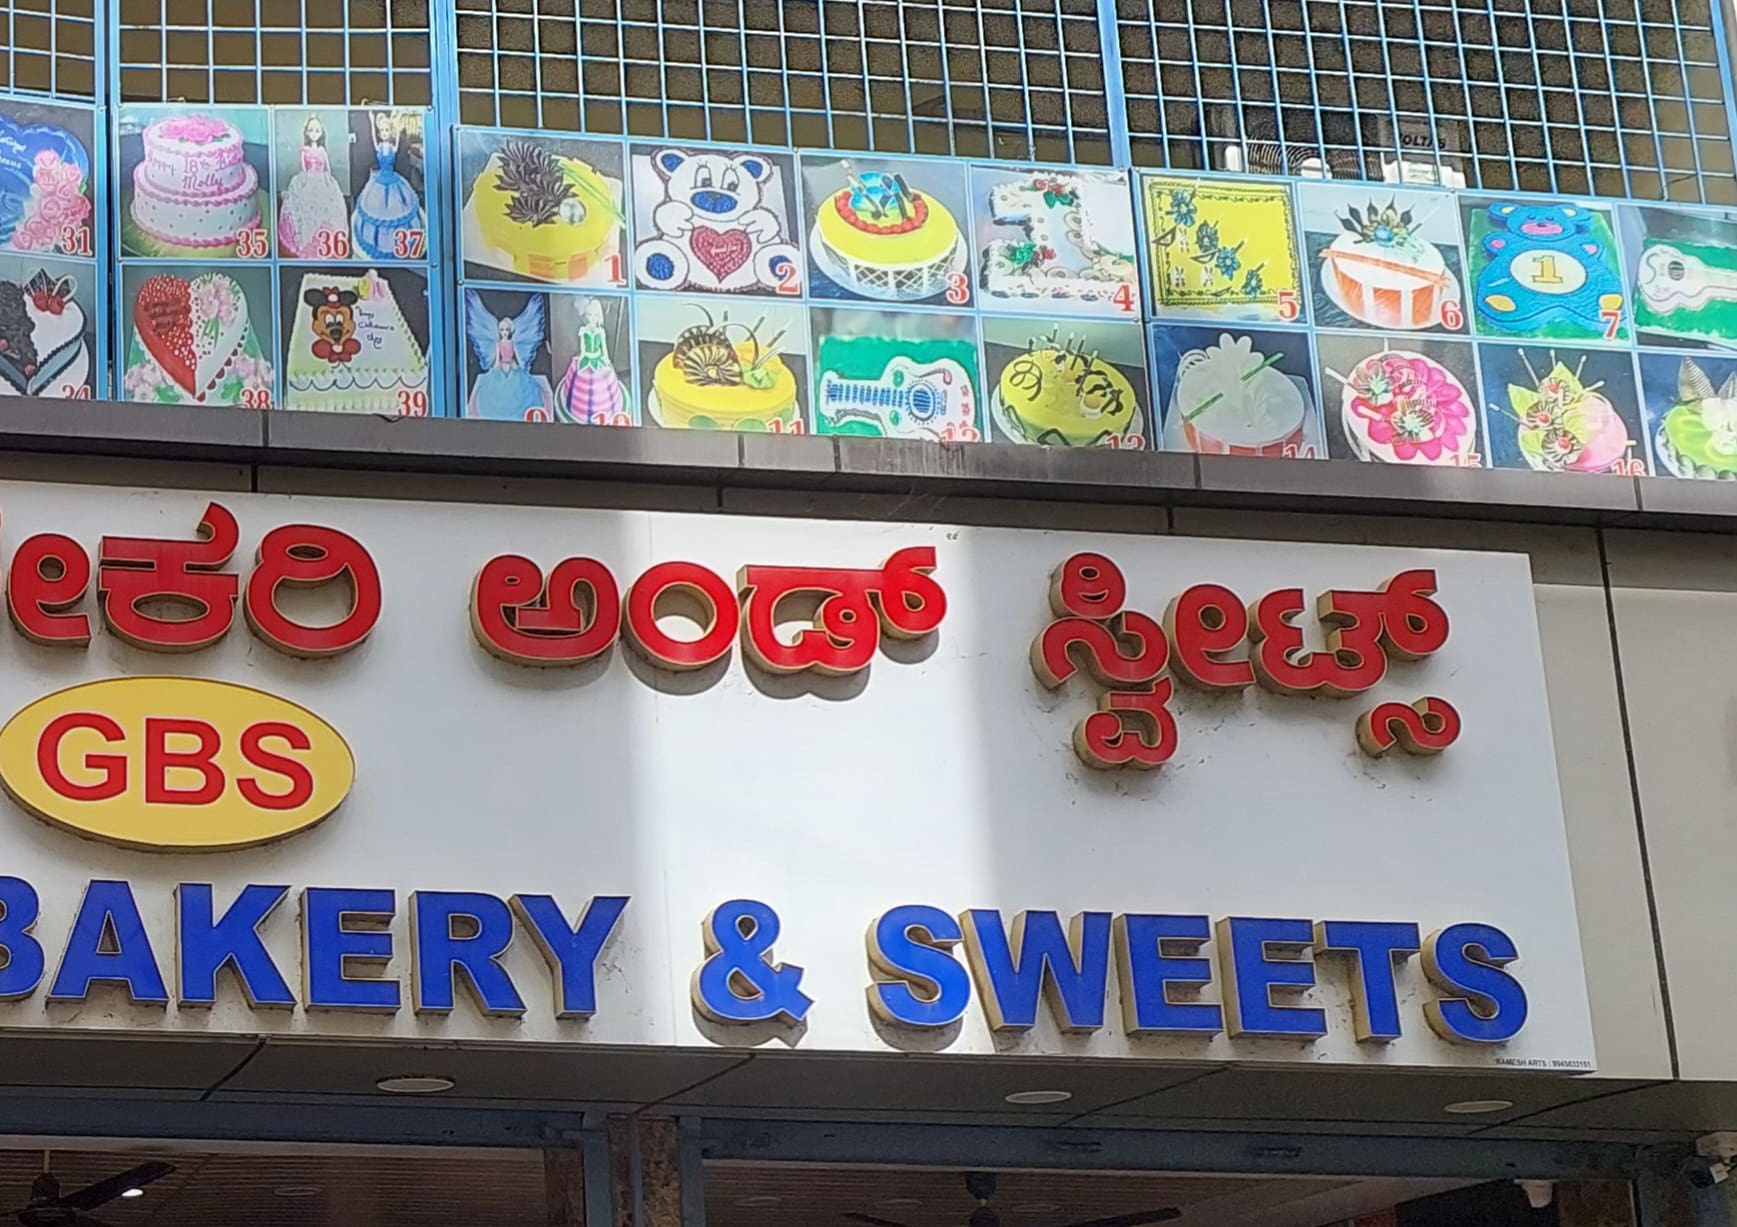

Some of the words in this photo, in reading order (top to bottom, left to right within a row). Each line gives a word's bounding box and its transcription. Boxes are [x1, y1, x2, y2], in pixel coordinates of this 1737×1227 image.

[1395, 133, 1446, 149] OLTS
[63, 227, 90, 253] 31
[238, 232, 267, 257] 35
[319, 232, 348, 257] 36
[394, 232, 424, 257] 37
[604, 255, 625, 283] 1
[777, 264, 798, 292] 2
[948, 275, 968, 302] 3
[1113, 285, 1134, 310] 4
[1278, 292, 1297, 319] 5
[1441, 302, 1462, 328] 6
[1601, 311, 1620, 338] 7
[398, 391, 427, 416] 39
[472, 545, 948, 671] ಅಂಡ್
[1040, 553, 1459, 763] ಸ್ವೀಟ್ಸ್
[37, 712, 313, 810] GBS
[697, 899, 813, 1021] &
[875, 904, 1527, 1041] SWEETS
